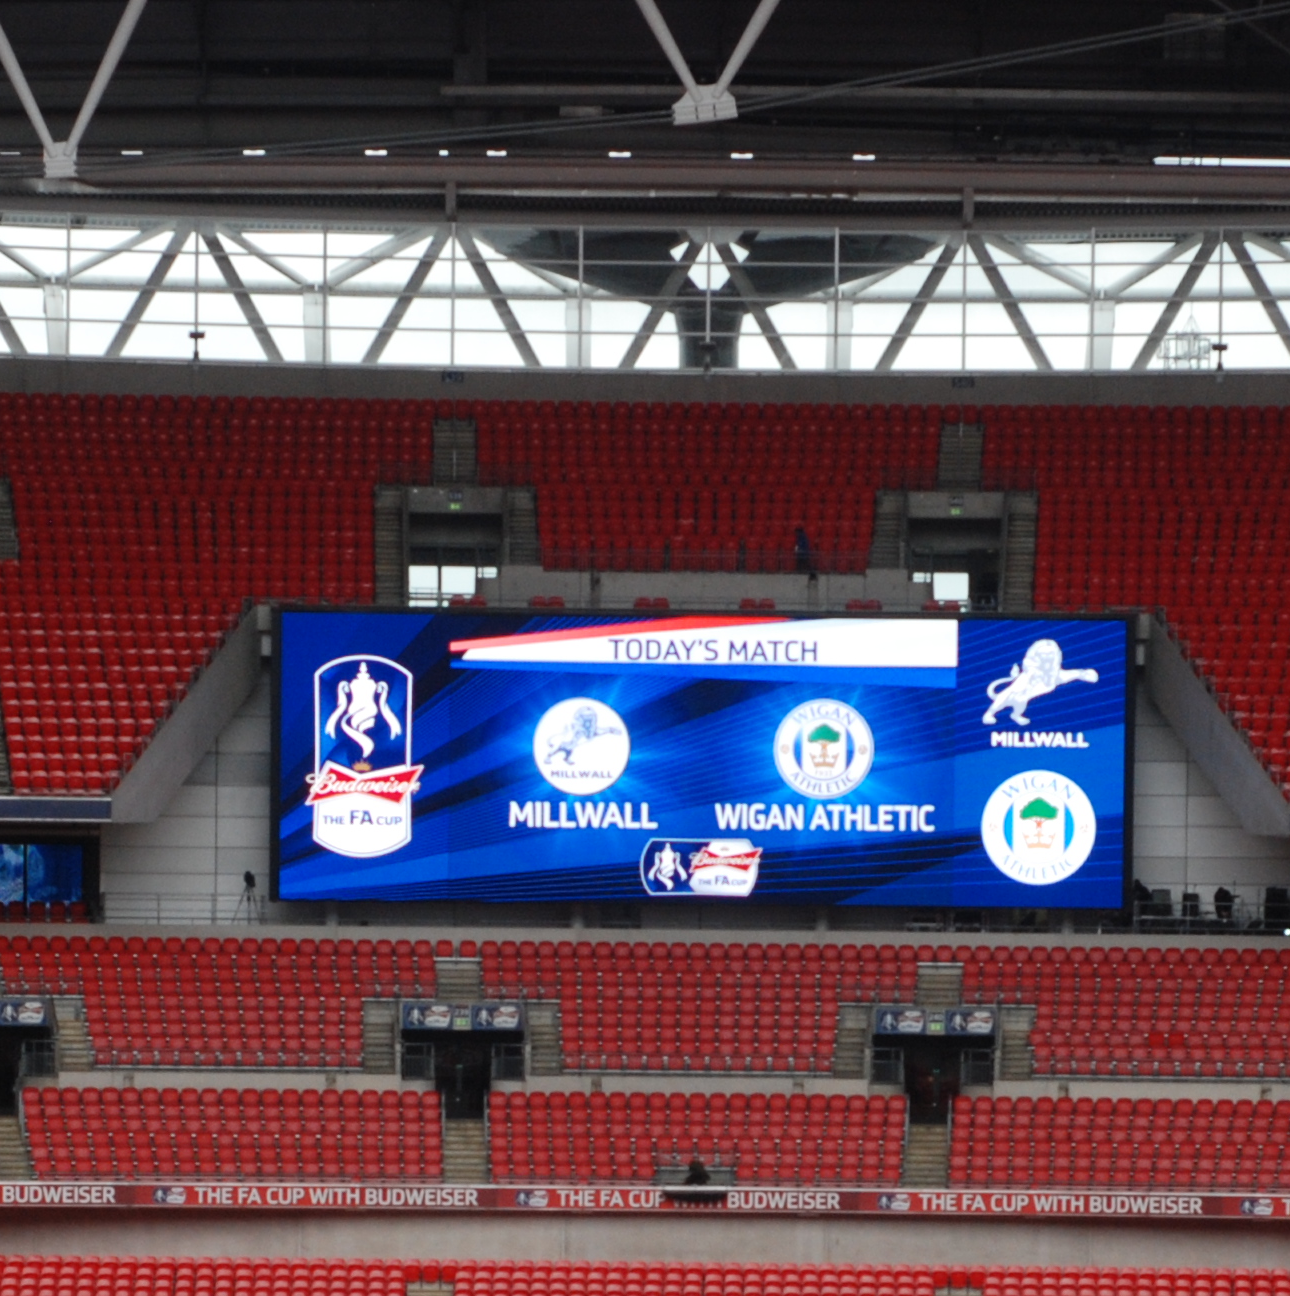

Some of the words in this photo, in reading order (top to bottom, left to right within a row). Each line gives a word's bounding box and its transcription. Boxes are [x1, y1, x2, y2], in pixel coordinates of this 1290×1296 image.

[608, 639, 719, 661] TODAY'S
[728, 640, 818, 662] MATCH
[792, 704, 854, 726] WIGAN
[990, 731, 1089, 748] MILLWALL
[305, 772, 421, 795] Budweiser
[550, 770, 613, 778] MILLWALL
[790, 771, 857, 794] ATHLETIC
[1001, 775, 1075, 800] WIGAN
[323, 815, 344, 825] THE
[349, 810, 374, 825] FA
[376, 815, 403, 825] CUP
[508, 800, 659, 829] MILLWALL
[714, 803, 804, 831] WIGAN
[809, 803, 936, 832] ATHLETIC
[714, 875, 730, 886] FA
[2, 1186, 115, 1203] BUDWEISER
[194, 1187, 234, 1204] THE
[238, 1186, 261, 1203] FA
[266, 1187, 305, 1204] CUP
[309, 1187, 361, 1204] WITH
[365, 1188, 478, 1205] BUDWEISER
[557, 1189, 595, 1206] THE
[600, 1189, 624, 1206] FA
[629, 1190, 665, 1207] CUP
[728, 1191, 840, 1209] BUDWEISER
[919, 1194, 958, 1211] THE
[962, 1193, 987, 1210] FA
[991, 1194, 1029, 1211] CUP
[1033, 1194, 1086, 1211] WITH
[1089, 1195, 1203, 1213] BUDWEISER
